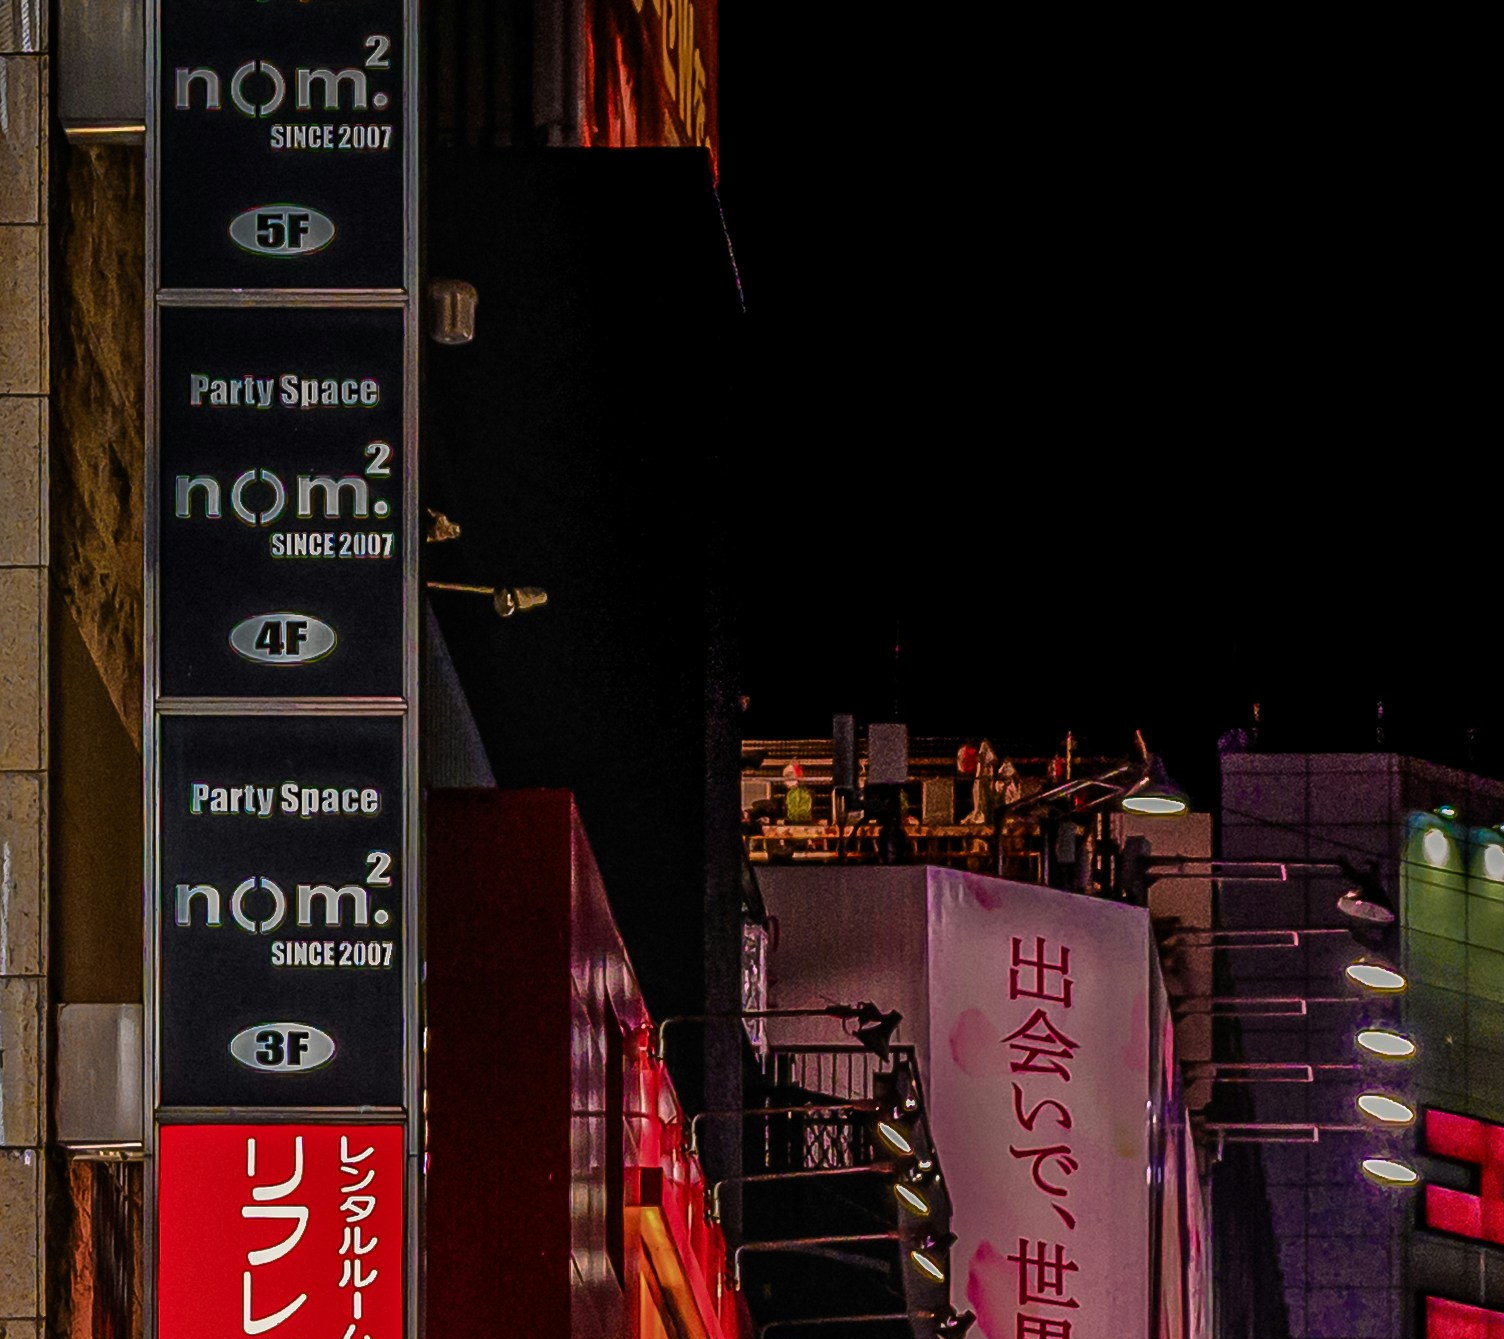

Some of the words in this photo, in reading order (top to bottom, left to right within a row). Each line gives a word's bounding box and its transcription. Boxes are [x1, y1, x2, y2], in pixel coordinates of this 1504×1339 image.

[270, 125, 334, 150] SINCE
[338, 125, 392, 150] 2007
[255, 213, 310, 250] 5F
[190, 373, 275, 410] Party
[279, 373, 380, 409] Space
[270, 533, 334, 558] SINCE
[338, 533, 393, 558] 2007
[254, 620, 309, 657] 4F
[190, 782, 275, 818] Party
[280, 781, 381, 817] Space
[271, 942, 336, 967] SINCE
[339, 942, 393, 967] 2007
[255, 1030, 310, 1067] 3F
